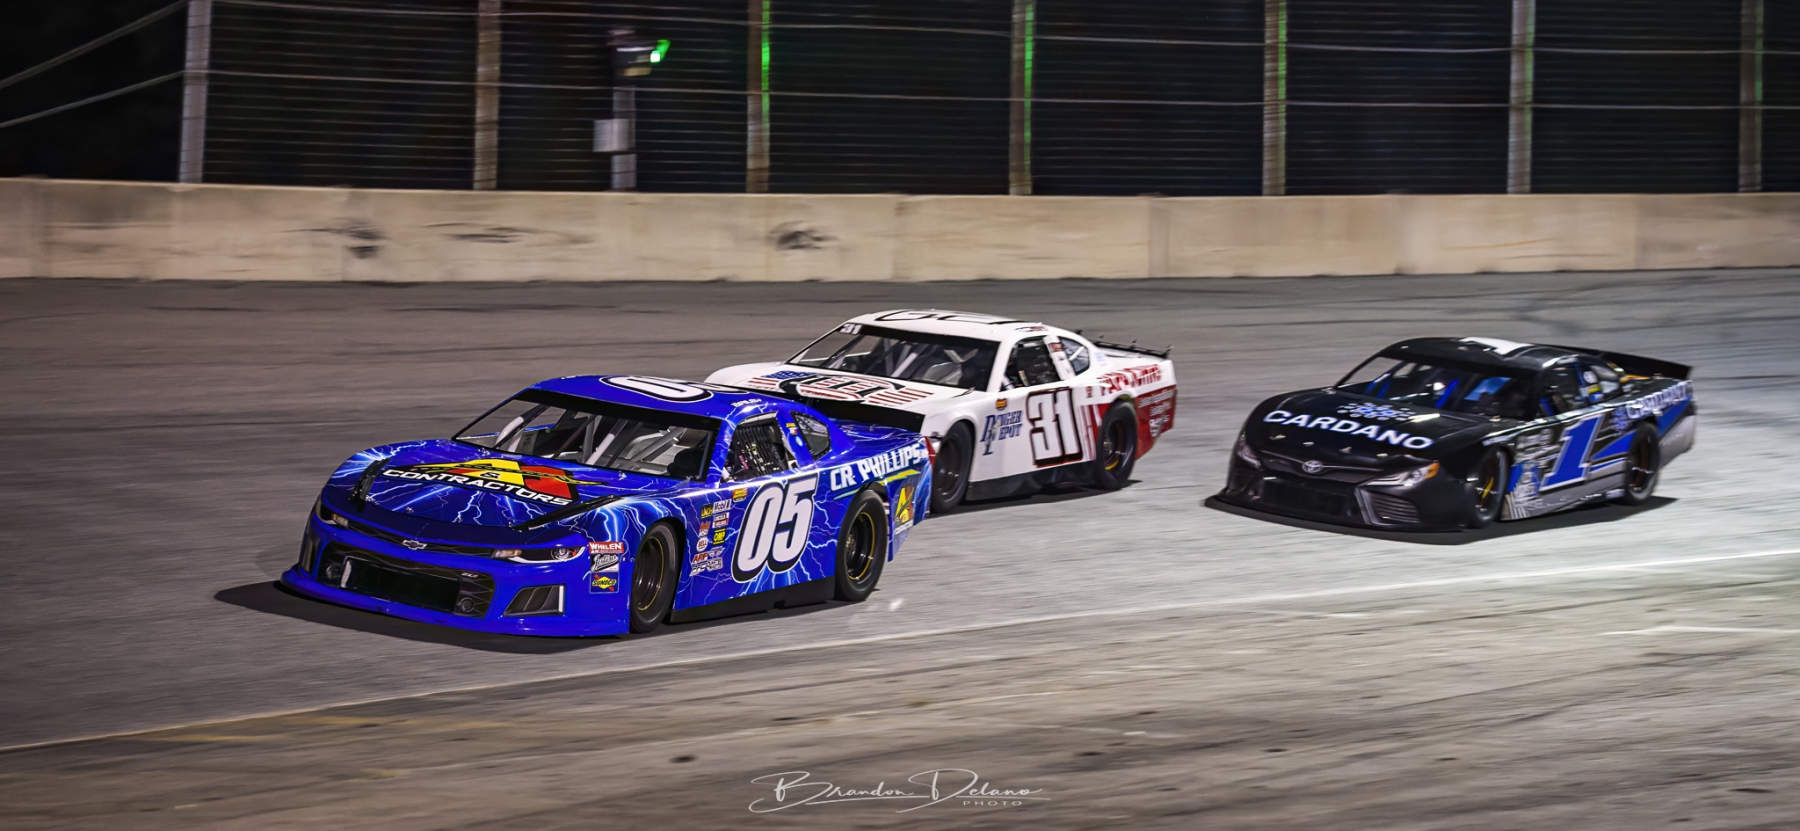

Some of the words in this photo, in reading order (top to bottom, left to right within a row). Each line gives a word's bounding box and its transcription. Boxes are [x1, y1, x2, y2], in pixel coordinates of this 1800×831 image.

[1026, 387, 1083, 468] 31
[1263, 410, 1435, 449] CARDANO
[830, 466, 857, 491] CR
[857, 443, 920, 483] PHILLIPS
[1539, 413, 1605, 491] 1
[382, 469, 573, 506] CONTRACTORS
[732, 472, 820, 582] 05
[592, 579, 617, 587] SUNOCO
